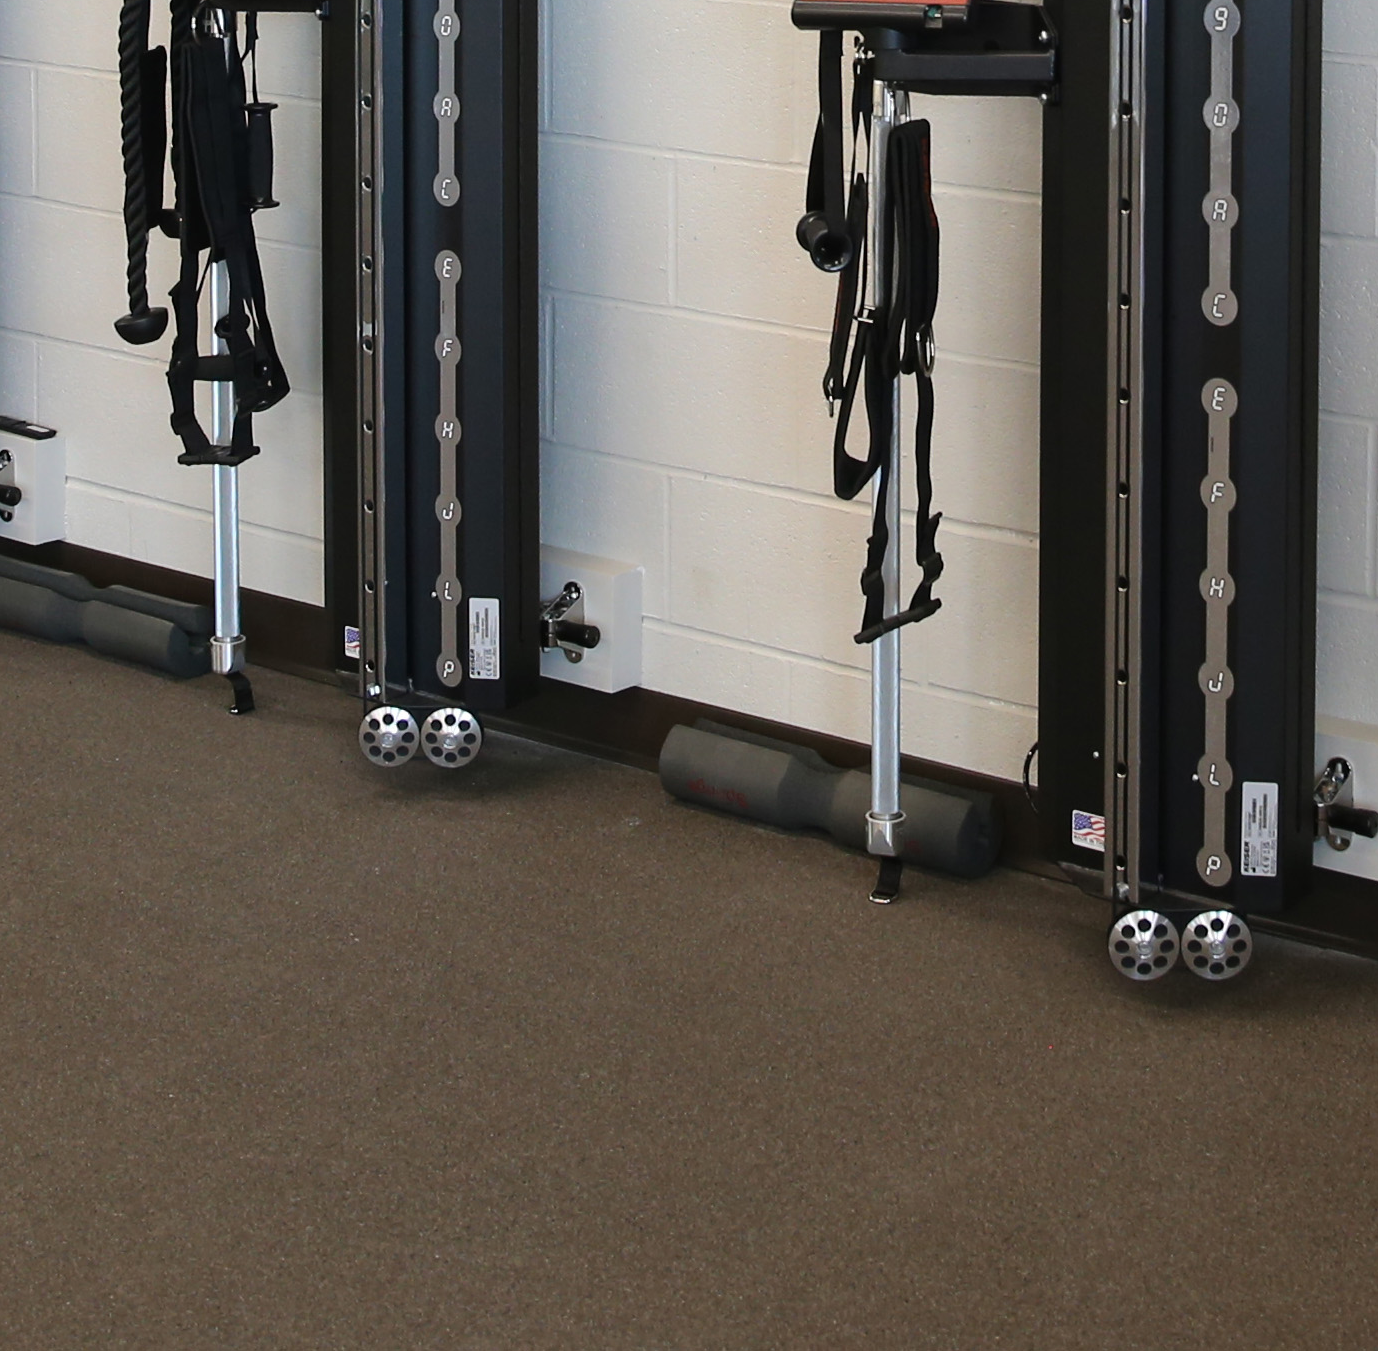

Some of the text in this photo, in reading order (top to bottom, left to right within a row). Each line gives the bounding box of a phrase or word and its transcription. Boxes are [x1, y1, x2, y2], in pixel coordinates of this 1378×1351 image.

[1214, 6, 1229, 32] 9
[1211, 293, 1227, 318] C
[1211, 386, 1226, 411] E
